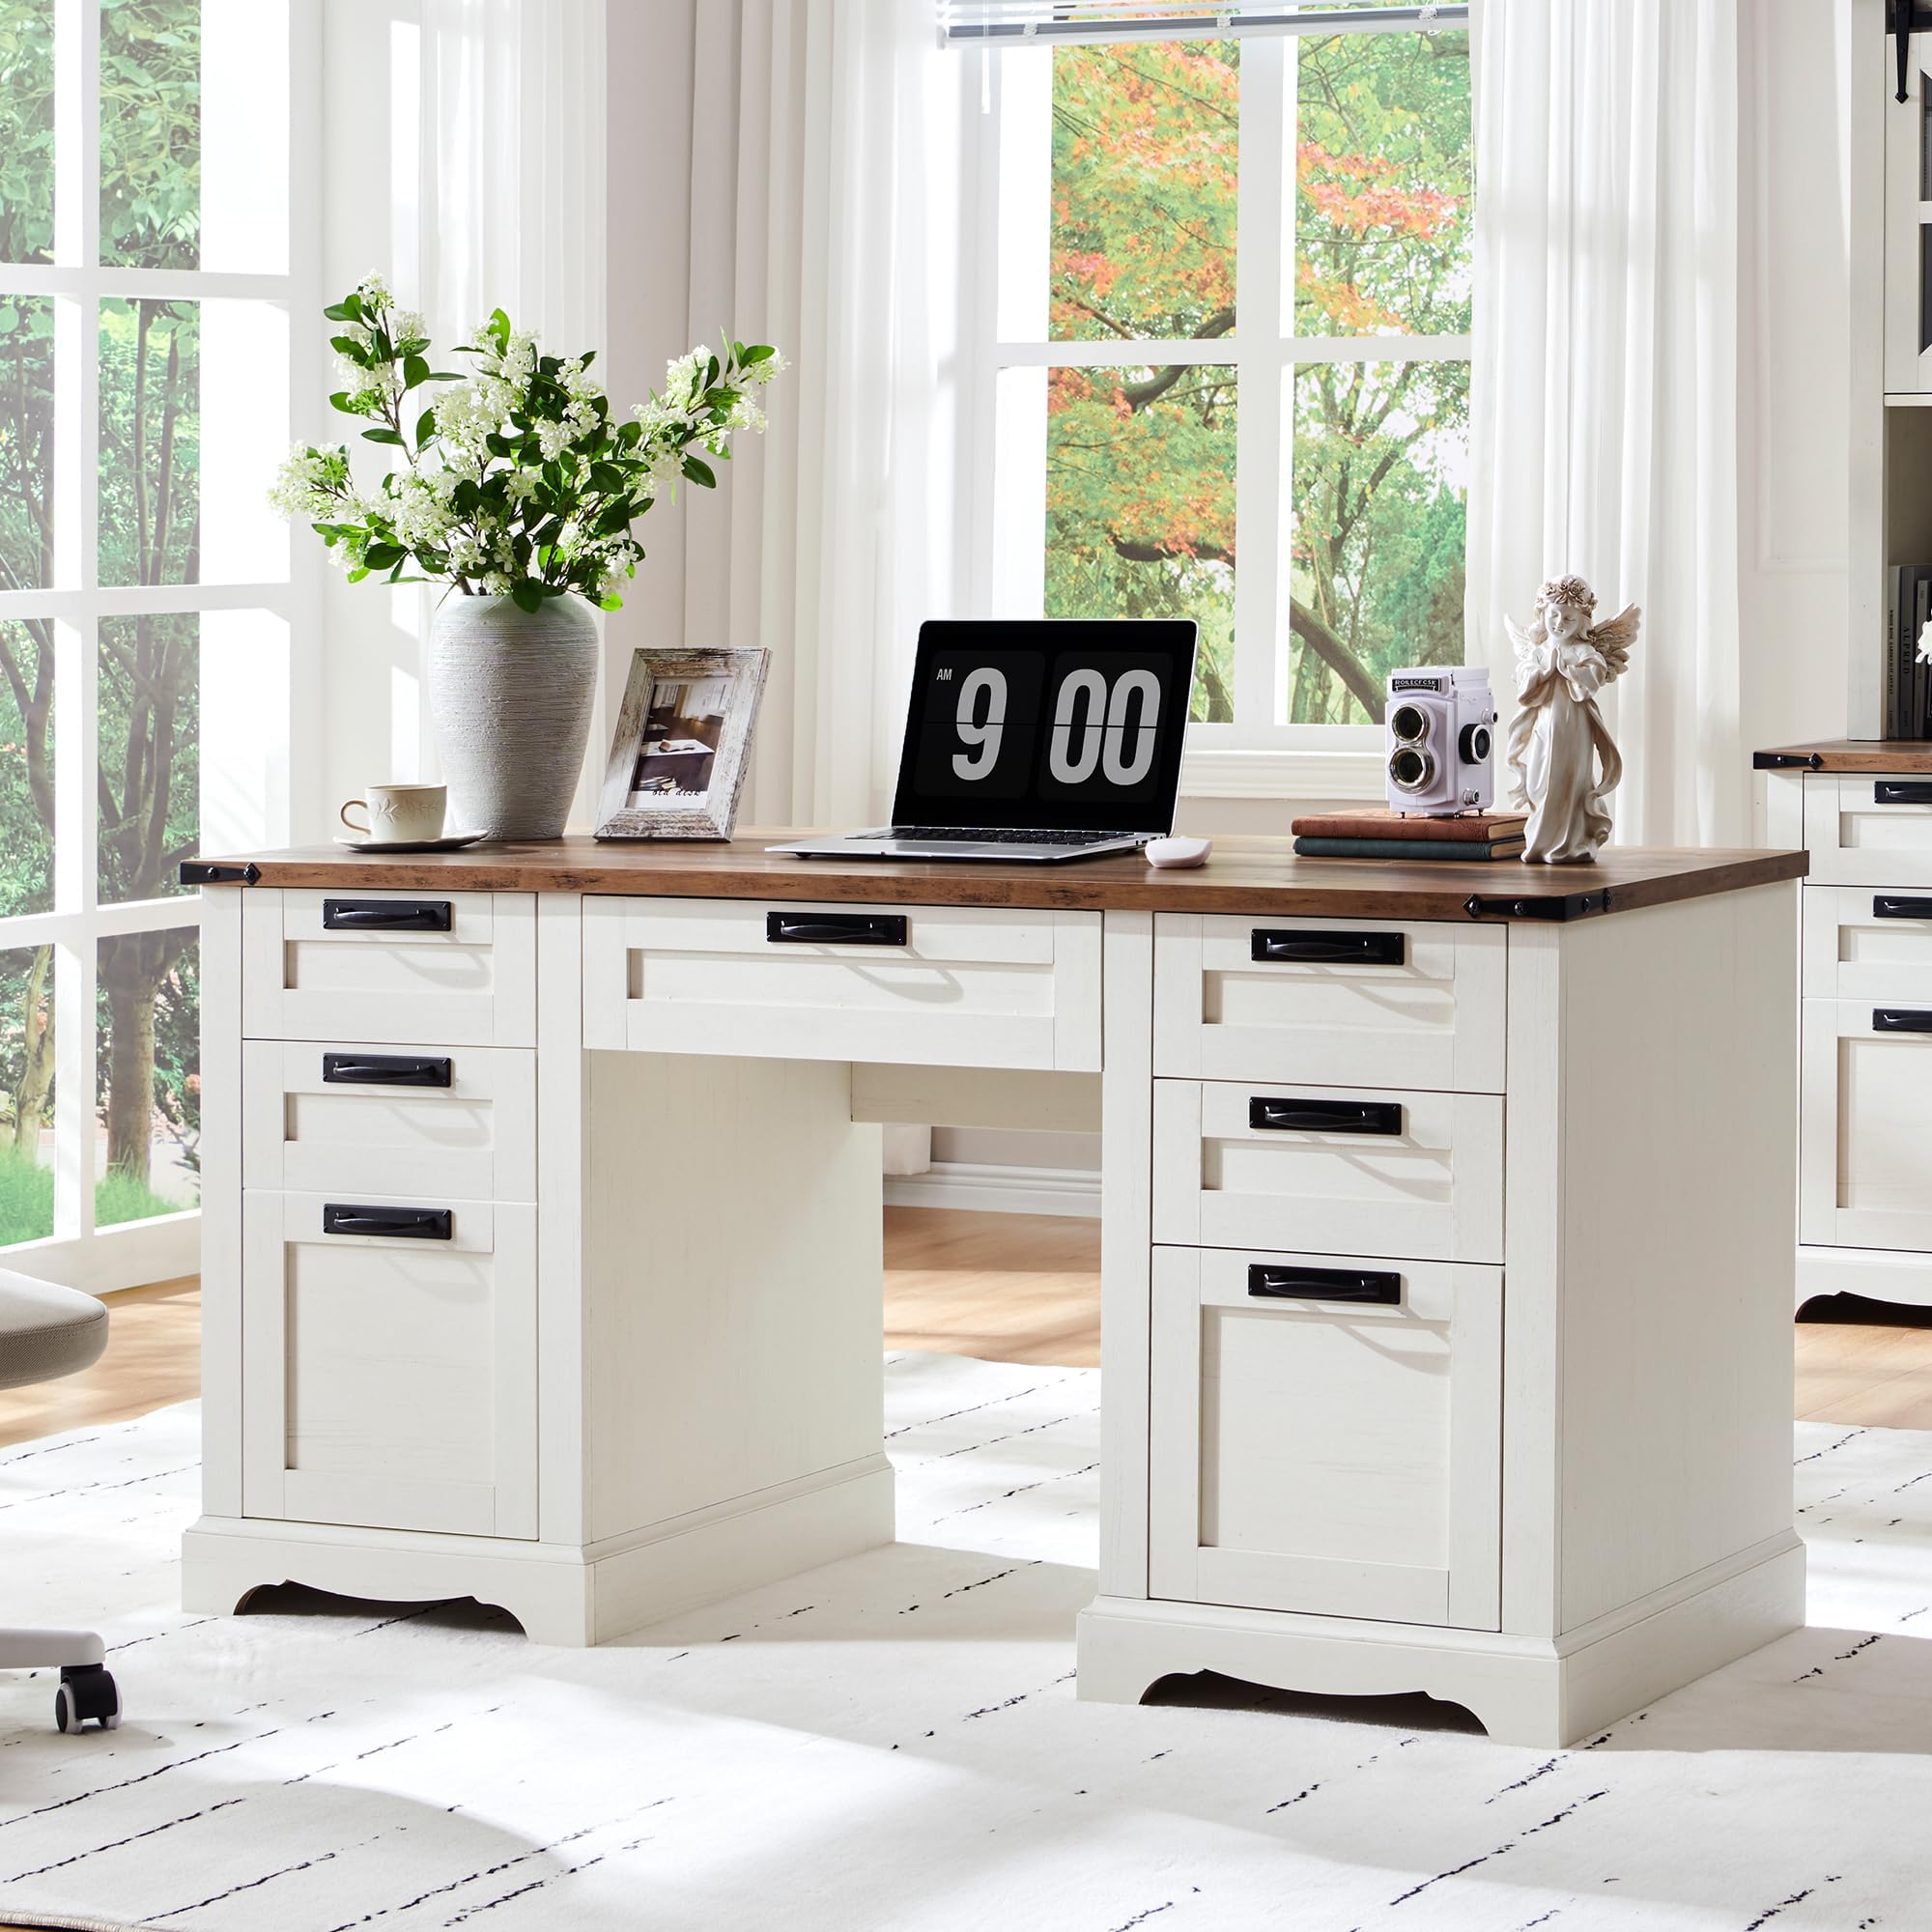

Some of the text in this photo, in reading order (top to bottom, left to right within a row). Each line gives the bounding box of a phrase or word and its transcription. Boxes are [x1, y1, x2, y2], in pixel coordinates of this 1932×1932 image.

[936, 668, 952, 681] AM
[952, 668, 1161, 785] 9 00
